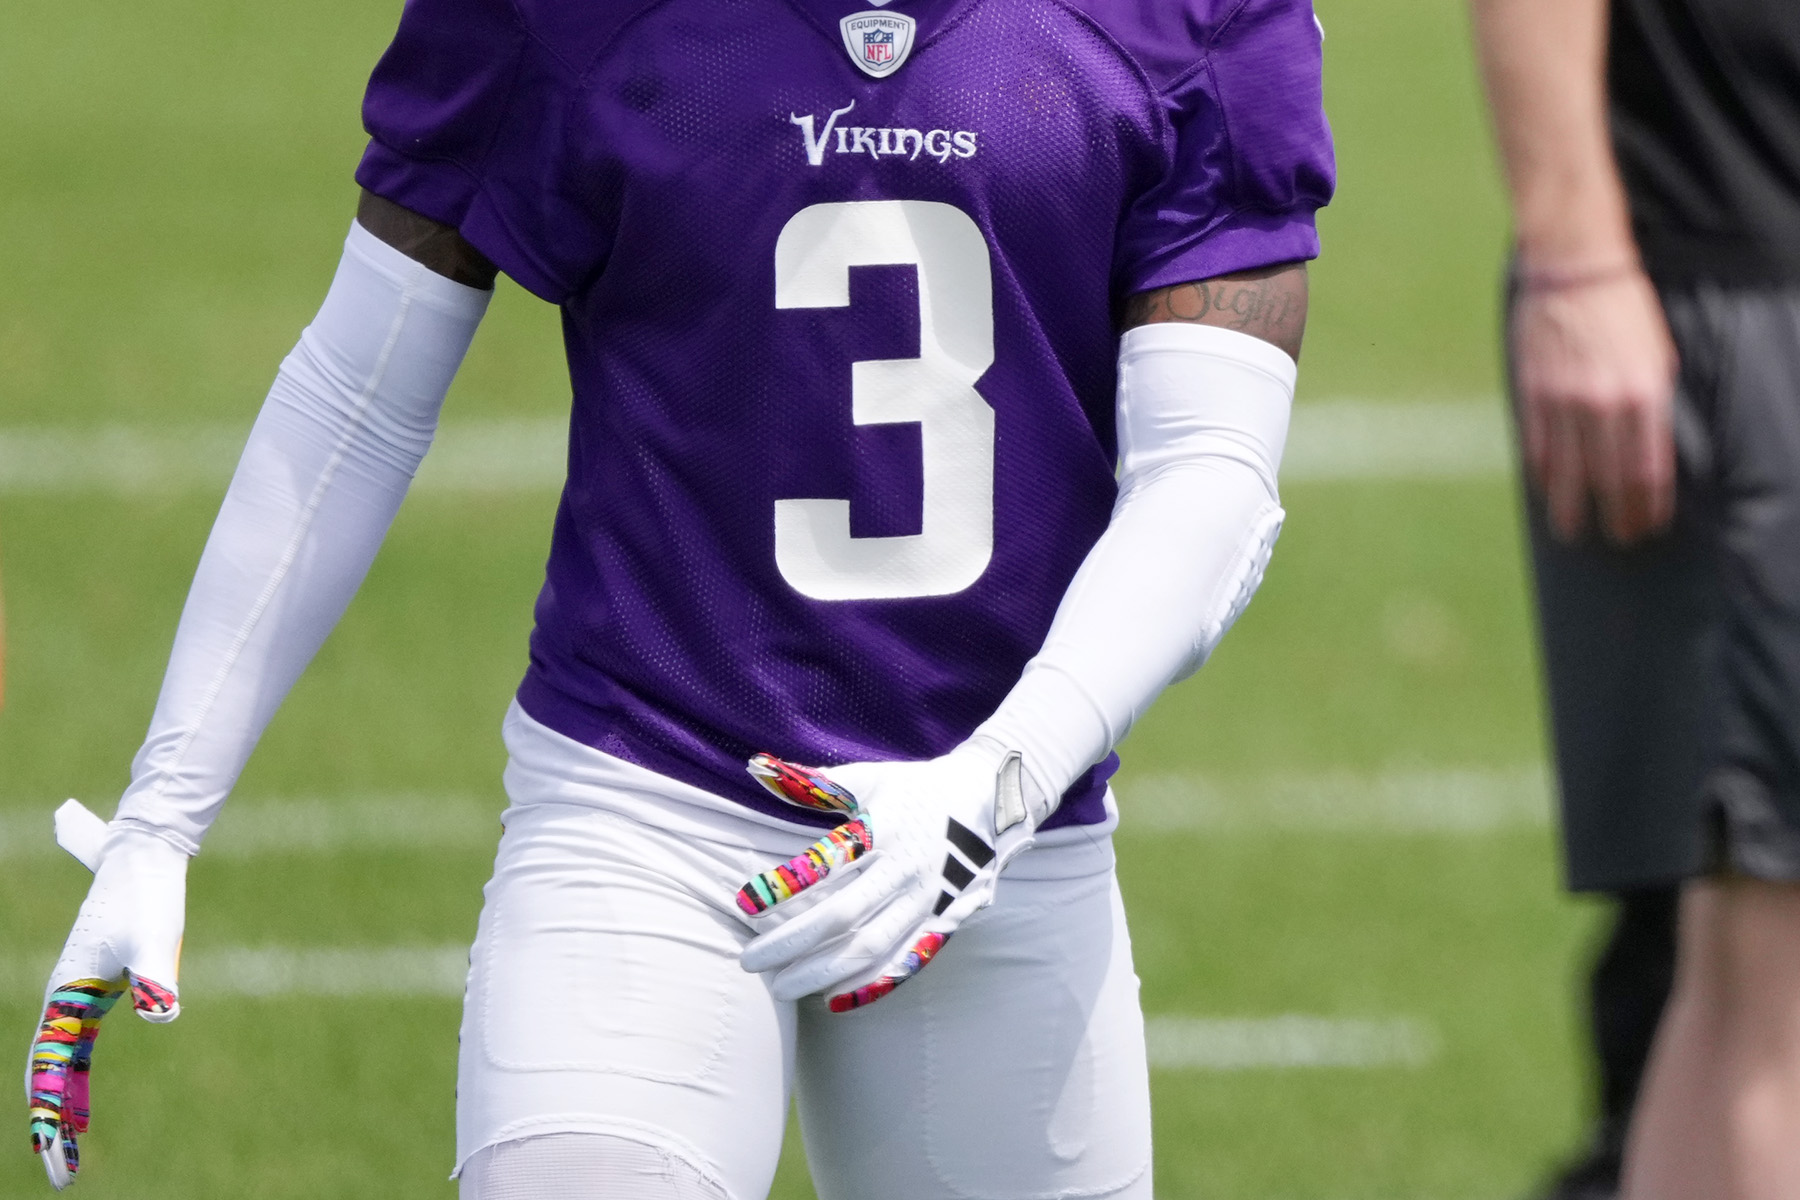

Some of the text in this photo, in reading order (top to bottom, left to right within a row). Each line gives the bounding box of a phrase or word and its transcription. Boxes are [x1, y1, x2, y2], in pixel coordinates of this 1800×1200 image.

[851, 19, 906, 31] EQUIPMENT
[866, 44, 892, 63] NFL
[775, 200, 995, 601] 3
